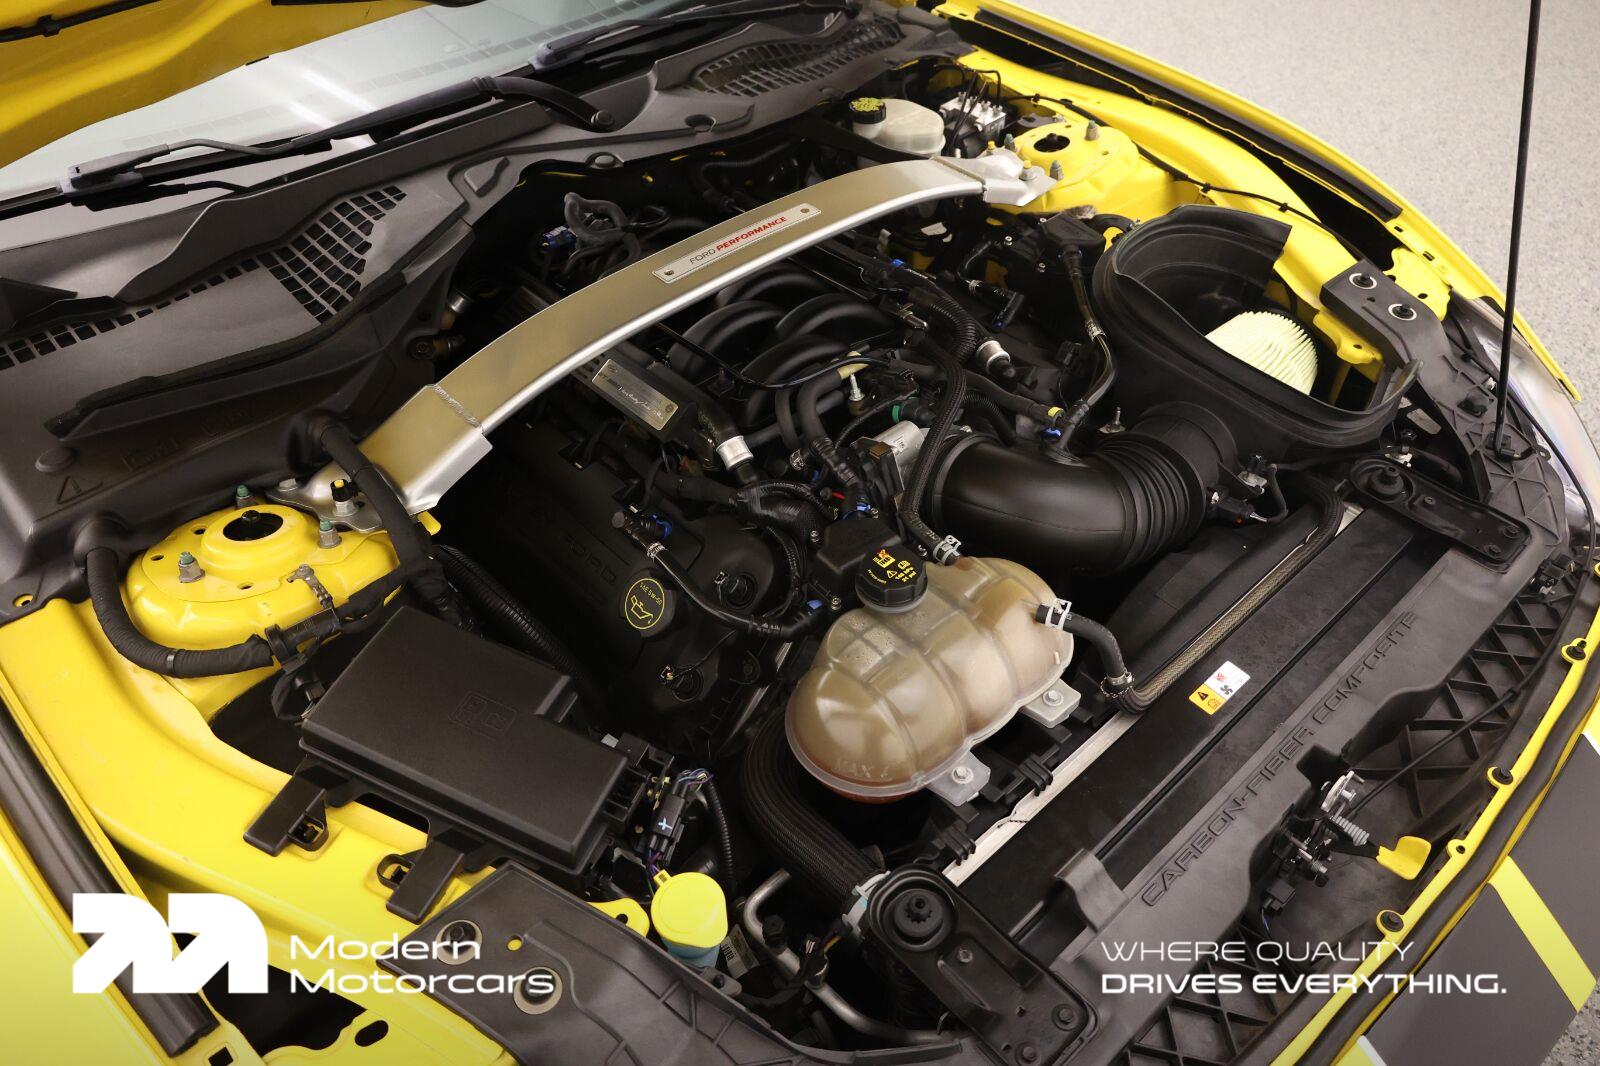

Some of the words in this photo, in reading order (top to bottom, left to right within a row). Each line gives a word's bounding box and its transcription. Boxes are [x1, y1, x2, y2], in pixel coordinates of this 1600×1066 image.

[689, 248, 716, 265] FORD
[716, 216, 787, 251] PERFORMANCE
[1312, 610, 1417, 725] COMPOSITE
